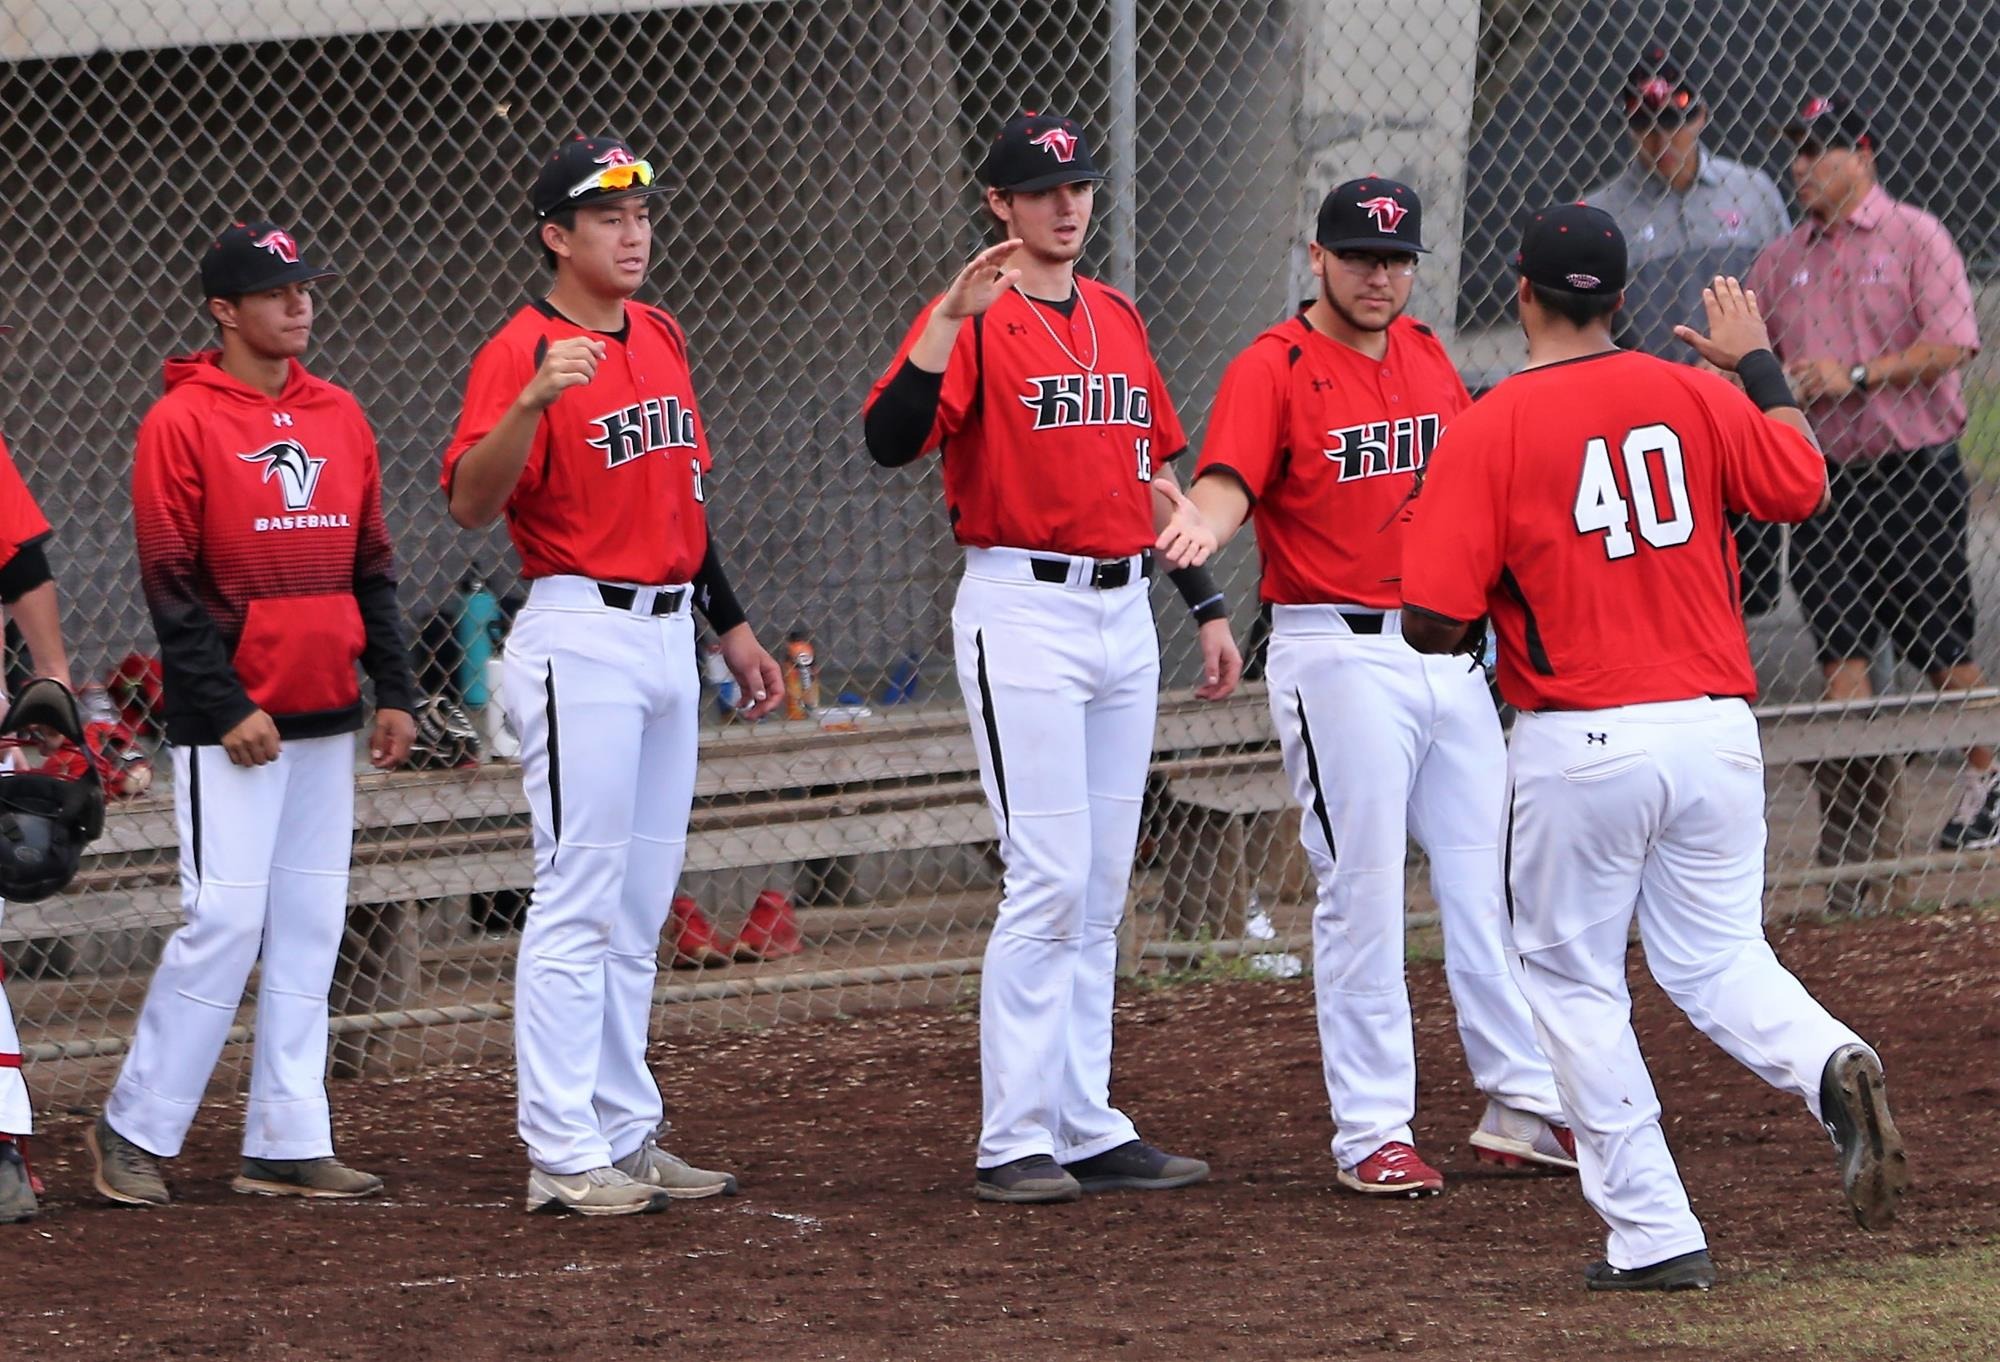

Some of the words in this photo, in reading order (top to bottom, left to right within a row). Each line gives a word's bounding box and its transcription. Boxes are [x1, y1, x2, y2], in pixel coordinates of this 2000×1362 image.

[585, 396, 698, 469] Hilo
[1018, 373, 1152, 430] Hilo
[1322, 412, 1446, 483] Hil
[254, 513, 351, 532] BASEBALL
[1572, 421, 1696, 561] 40
